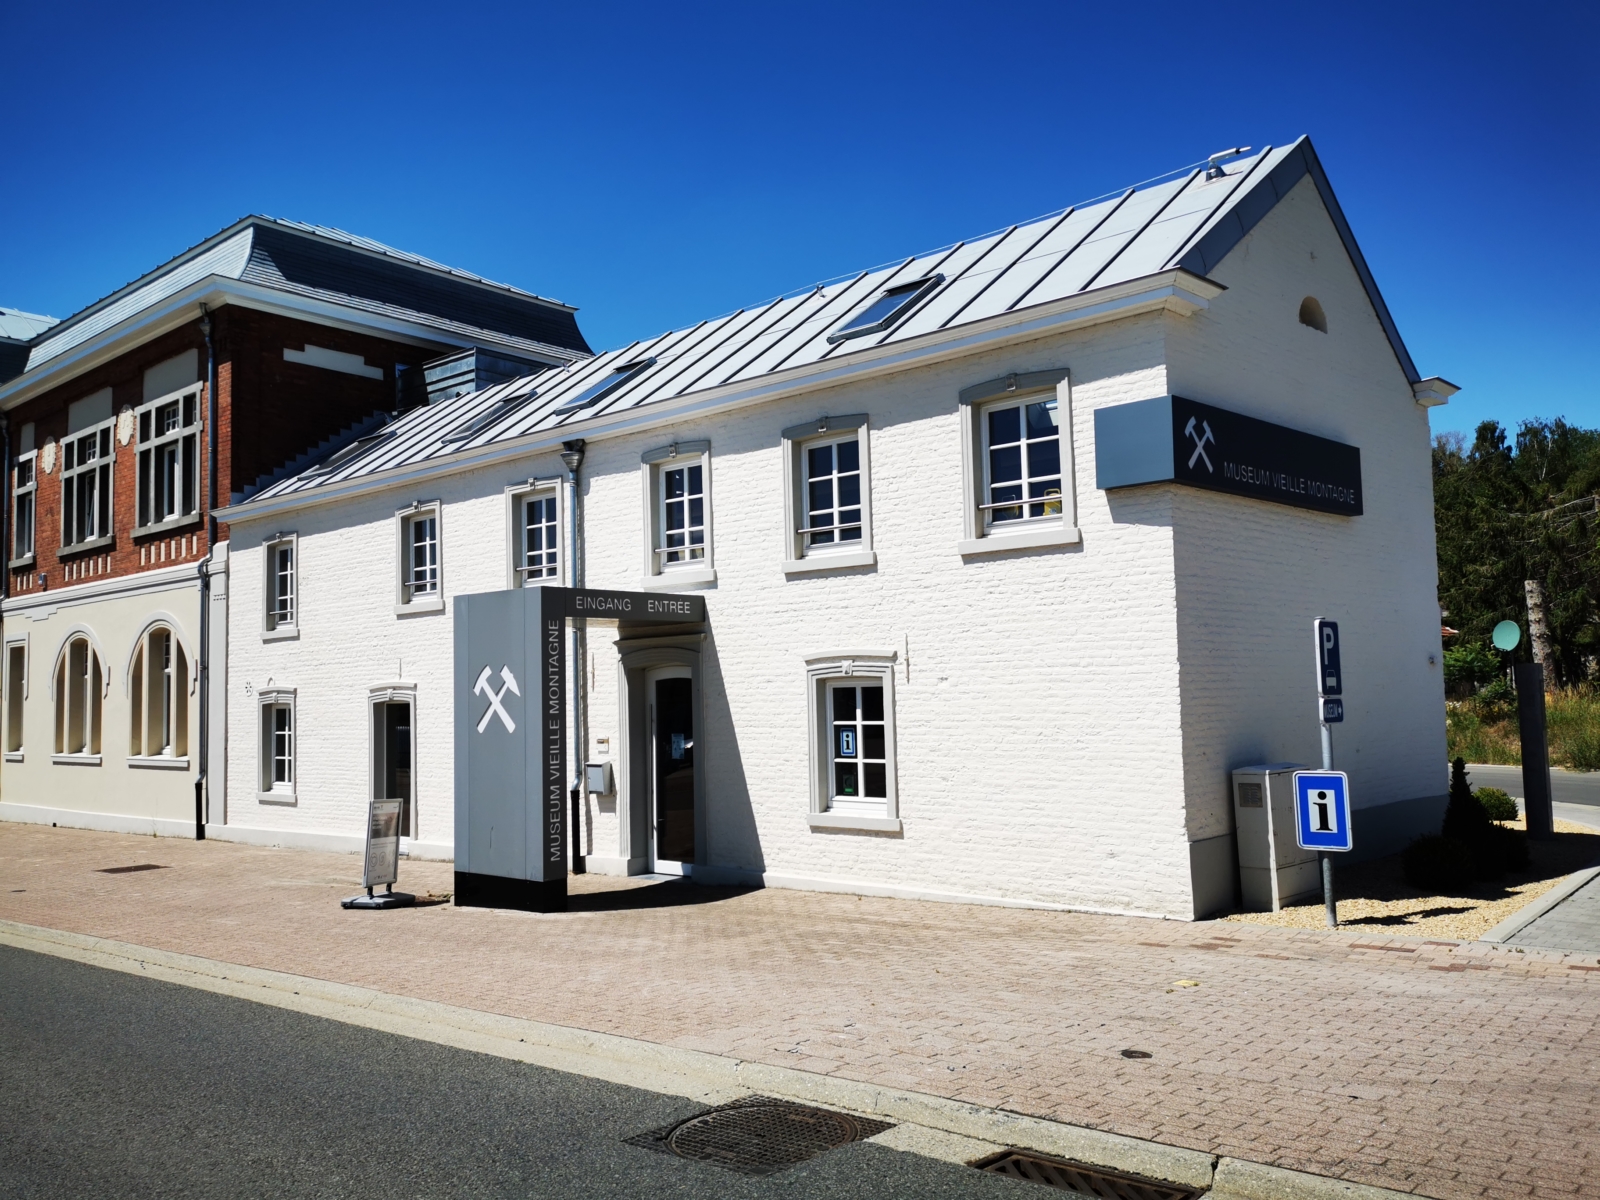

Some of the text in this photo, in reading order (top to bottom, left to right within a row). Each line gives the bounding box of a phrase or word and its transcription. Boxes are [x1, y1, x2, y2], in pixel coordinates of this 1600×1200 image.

[1224, 461, 1355, 504] MUSEUM VIEILLE MONTAGNE
[576, 596, 691, 614] EINGANG ENTRÉE
[1322, 626, 1335, 665] P
[548, 620, 561, 862] MUSEUM VIEILLE MONTAGNE
[1312, 790, 1333, 831] i
